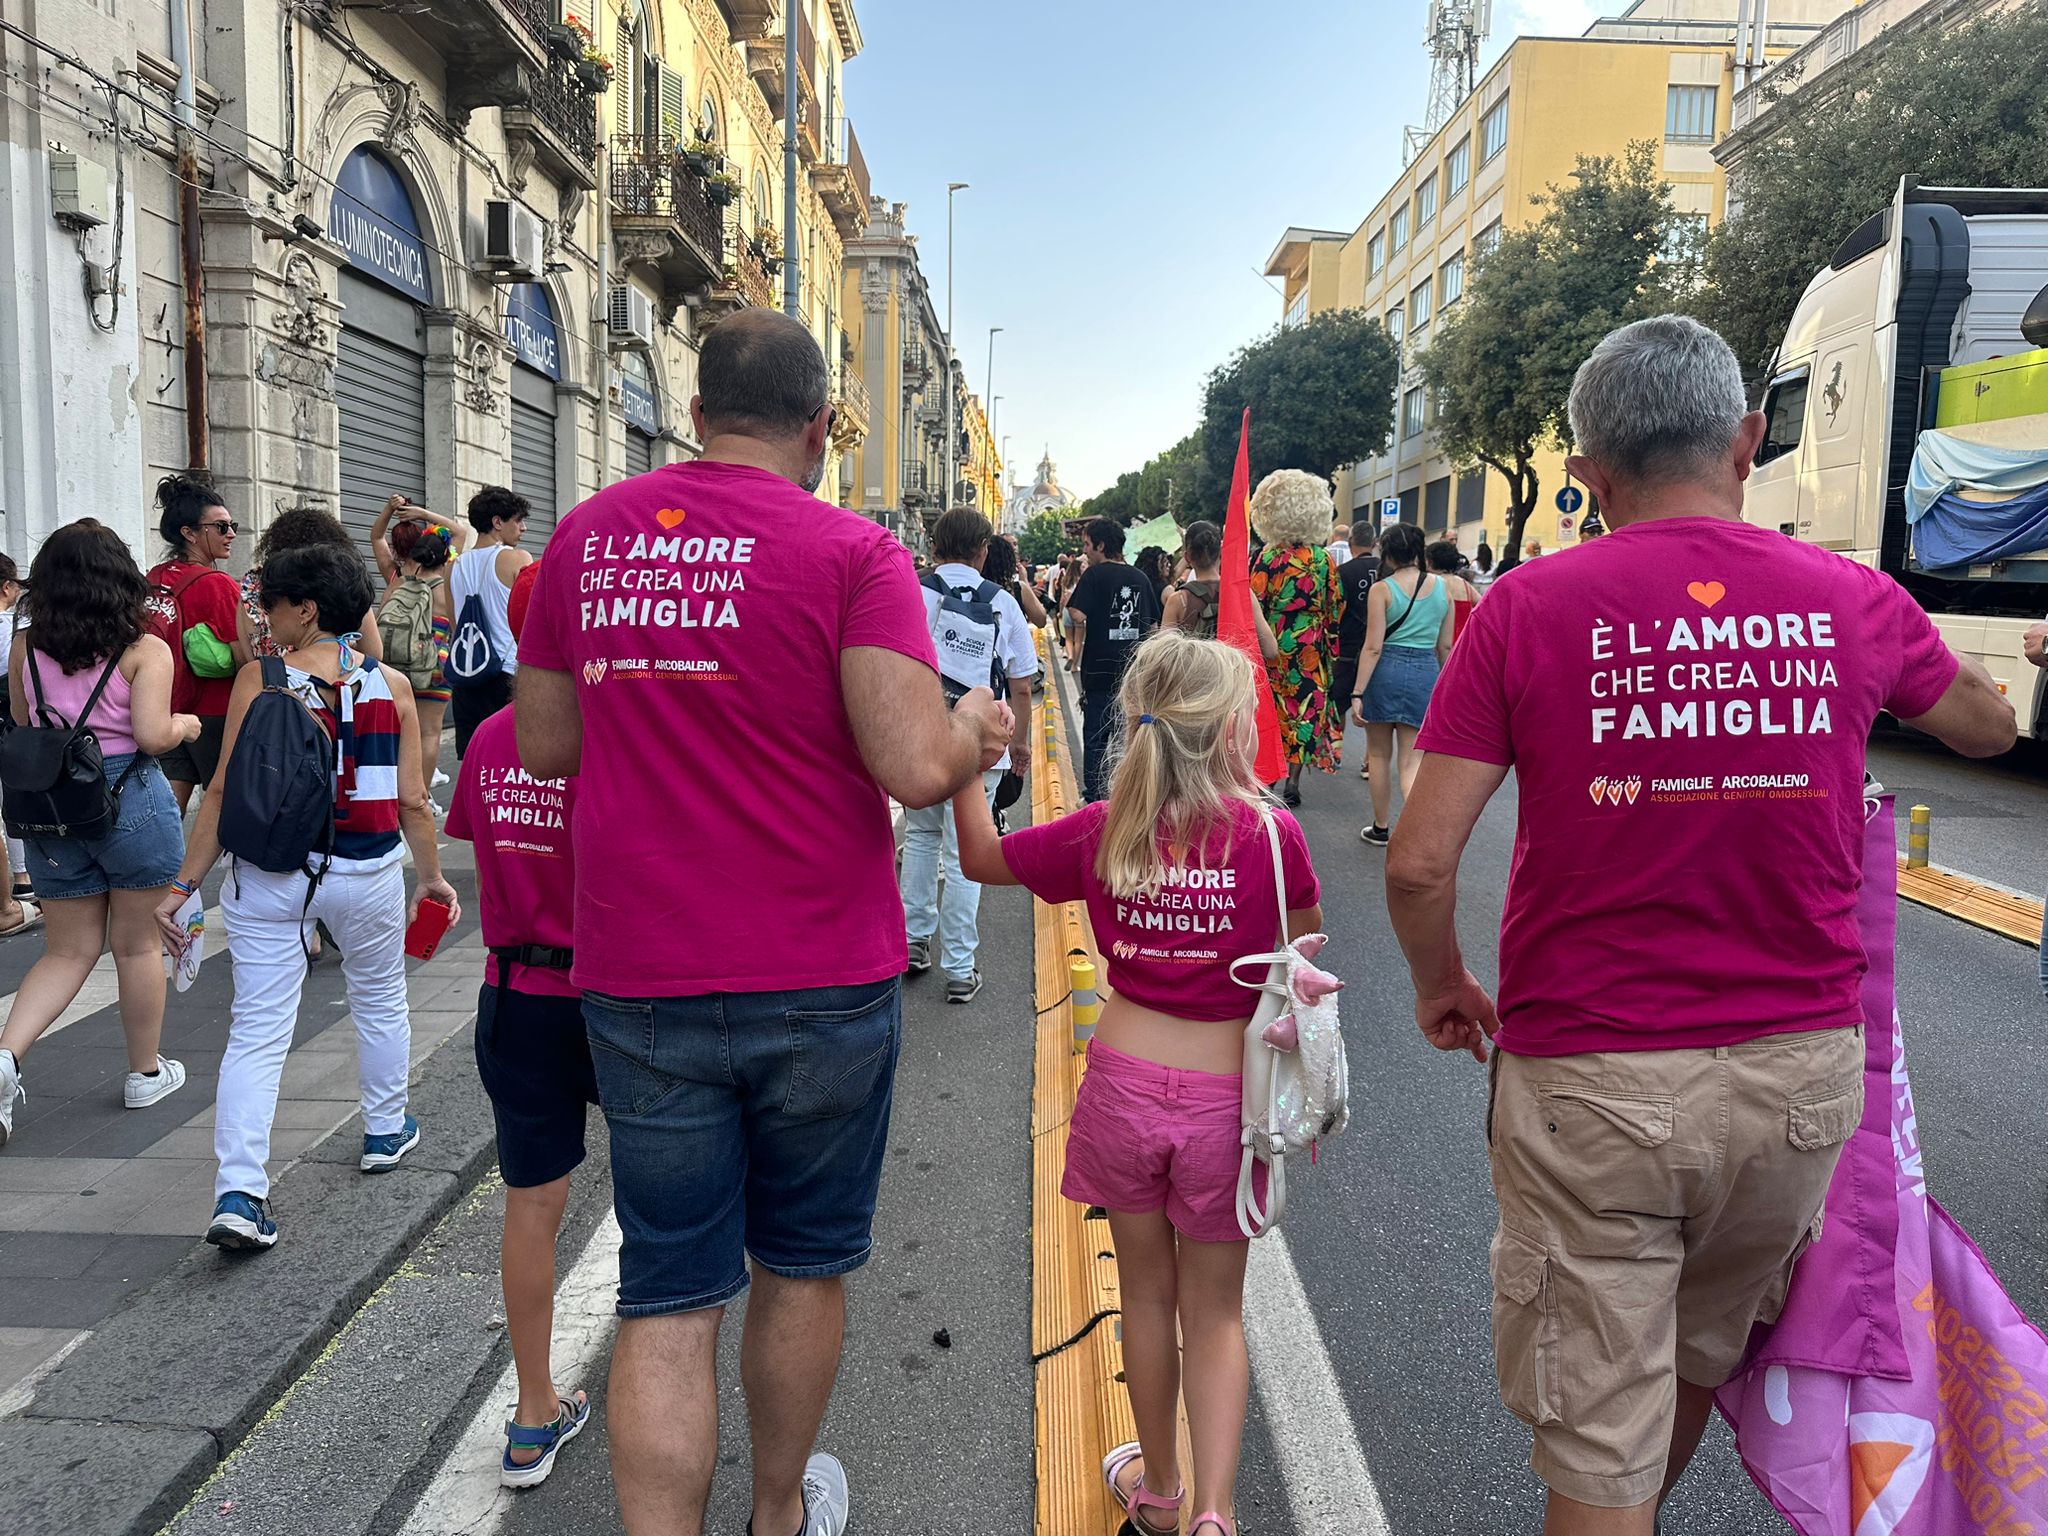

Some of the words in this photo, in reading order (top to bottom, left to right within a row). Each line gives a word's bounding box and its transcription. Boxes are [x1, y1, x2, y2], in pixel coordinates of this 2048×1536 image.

[328, 204, 425, 290] LLUMINOTECNICA
[533, 328, 556, 369] LUCE
[582, 531, 600, 563] È
[603, 533, 756, 563] L'AMORE
[580, 568, 617, 594] CHE
[621, 569, 683, 592] CREA
[692, 569, 745, 593] UNA
[580, 596, 741, 632] FAMIGLIA
[960, 641, 985, 652] FEDERALE
[966, 637, 986, 647] SCUOLA
[1591, 618, 1614, 661] È
[1628, 612, 1836, 655] L'AMORE
[612, 658, 650, 670] FAMIGLIE
[654, 659, 719, 671] ARCOBALENO
[686, 673, 739, 681] OMOSESSUALI
[1590, 665, 1656, 698] CHE
[1667, 660, 1760, 690] CREA
[1769, 658, 1839, 688] UNA
[1591, 697, 1833, 744] FAMIGLIA
[480, 766, 488, 787] È
[1651, 776, 1714, 793] FAMIGLIE
[1721, 773, 1810, 789] ARCOBALENO
[502, 788, 538, 805] CREA
[540, 792, 564, 810] UNA
[1650, 792, 1720, 803] ASSOCIAZIONE
[1723, 790, 1767, 801] GENITORI
[1768, 789, 1829, 799] OMOSESSUALI
[487, 805, 565, 830] AMIGLIA
[1198, 893, 1237, 911] UNA
[1116, 903, 1234, 934] FAMIGLIA
[1140, 948, 1170, 958] FAMIGLIE
[1173, 950, 1218, 959] ARCOBALENO
